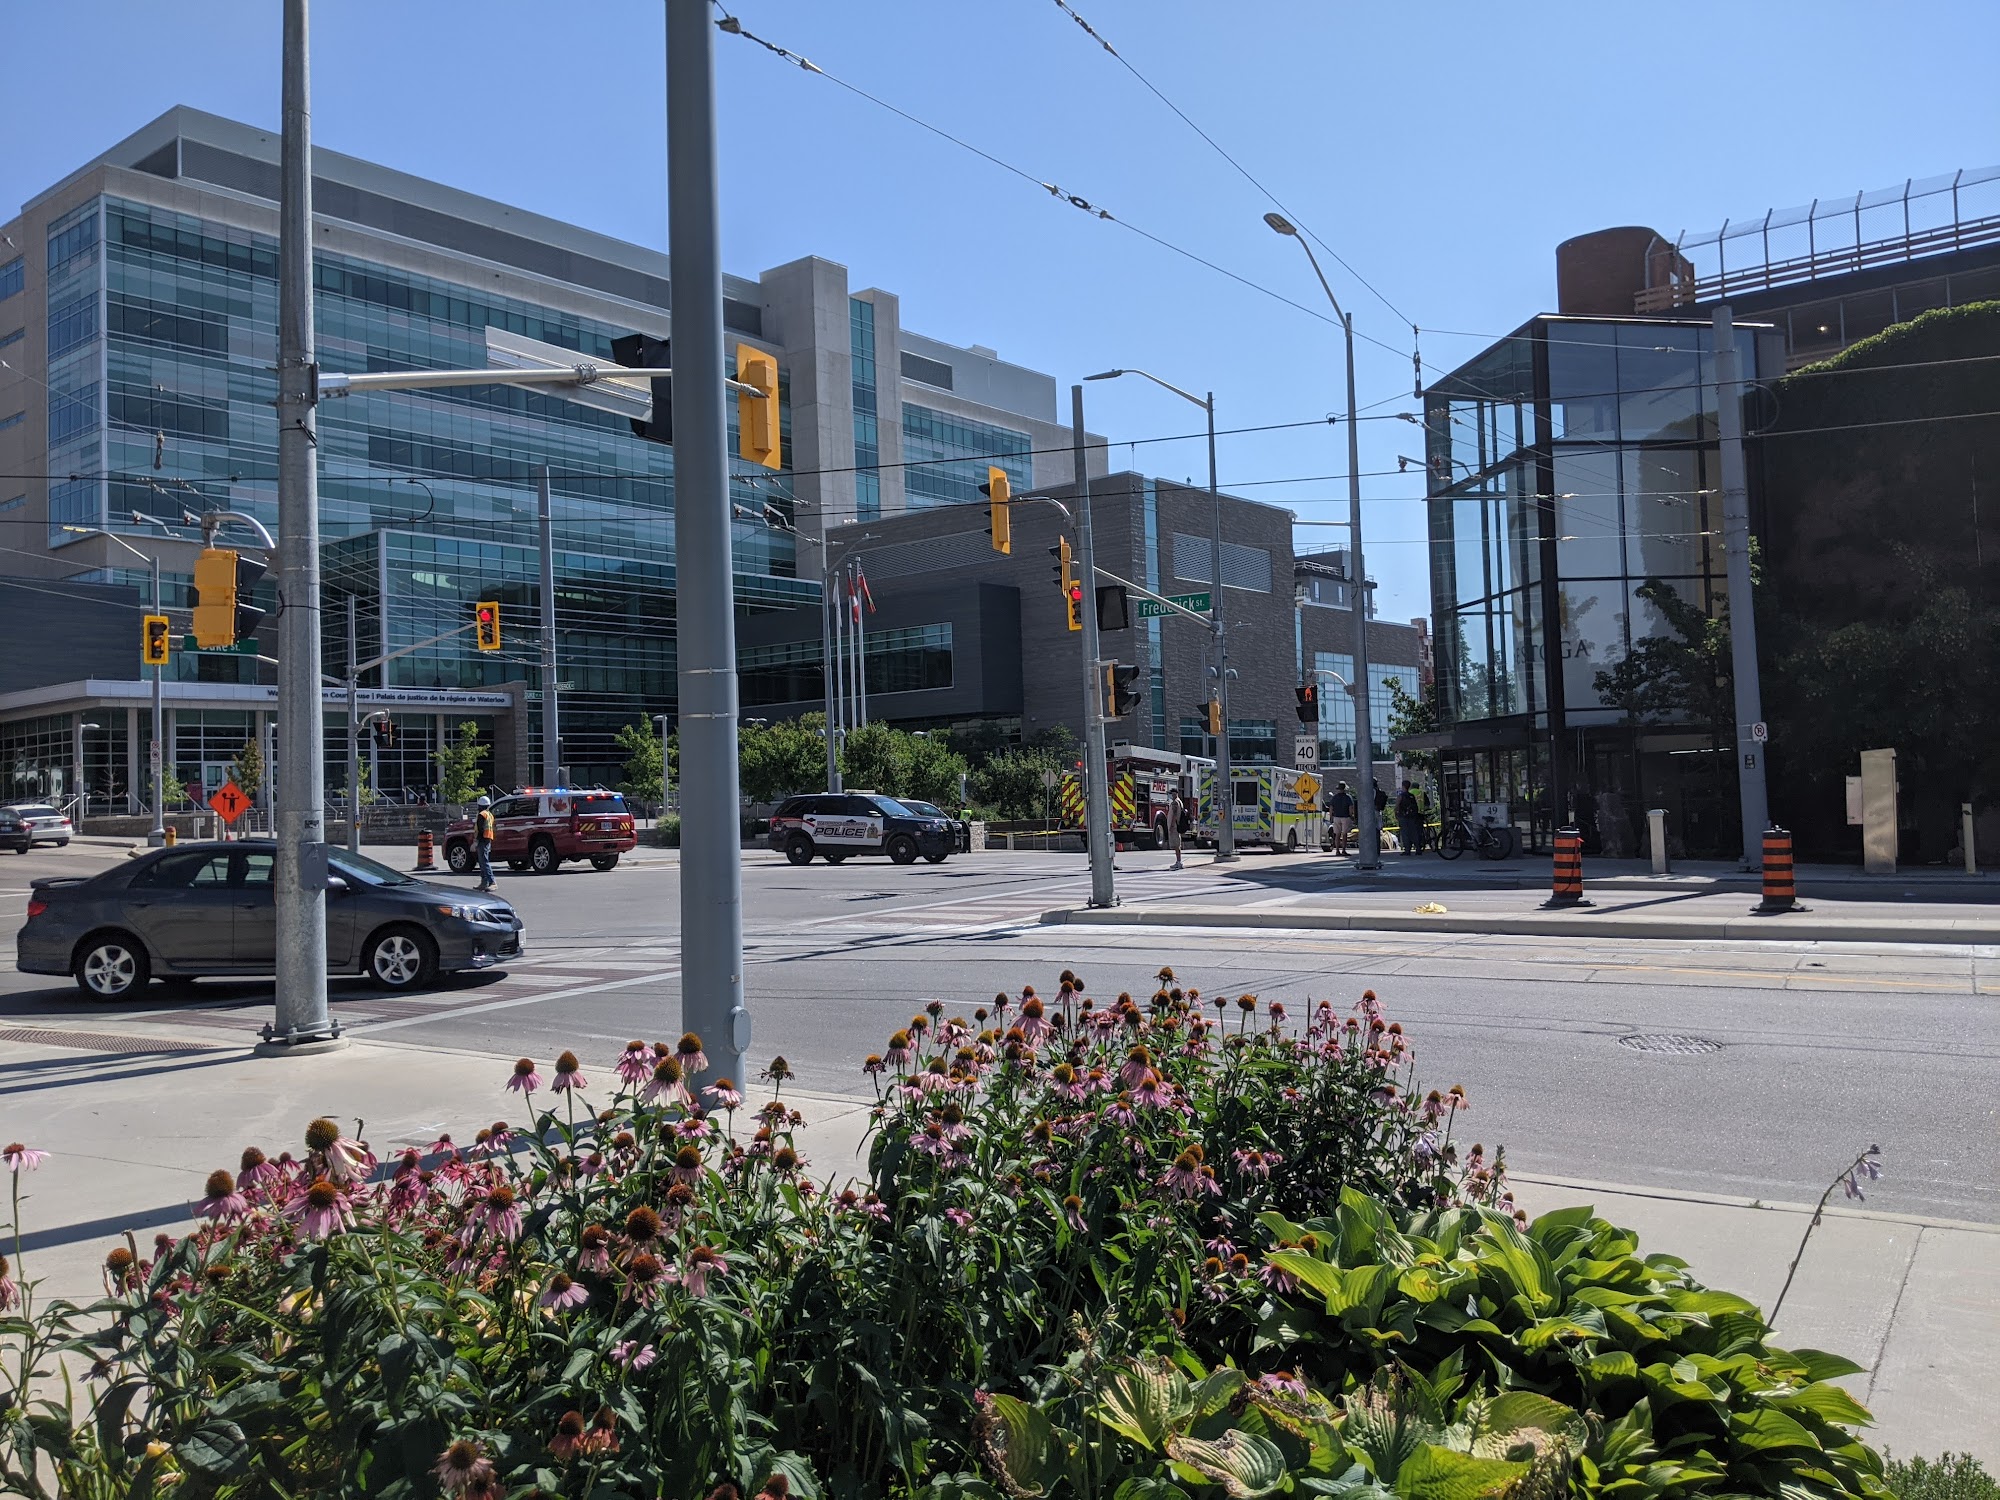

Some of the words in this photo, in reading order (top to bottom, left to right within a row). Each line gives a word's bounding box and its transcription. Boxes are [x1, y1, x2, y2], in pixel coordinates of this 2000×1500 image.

[1143, 597, 1195, 615] Fredick
[1196, 599, 1205, 607] St.
[447, 695, 466, 703] région
[1297, 746, 1314, 759] 40
[1153, 780, 1166, 791] FIRE
[1487, 806, 1498, 815] 49
[812, 827, 867, 838] POLICE
